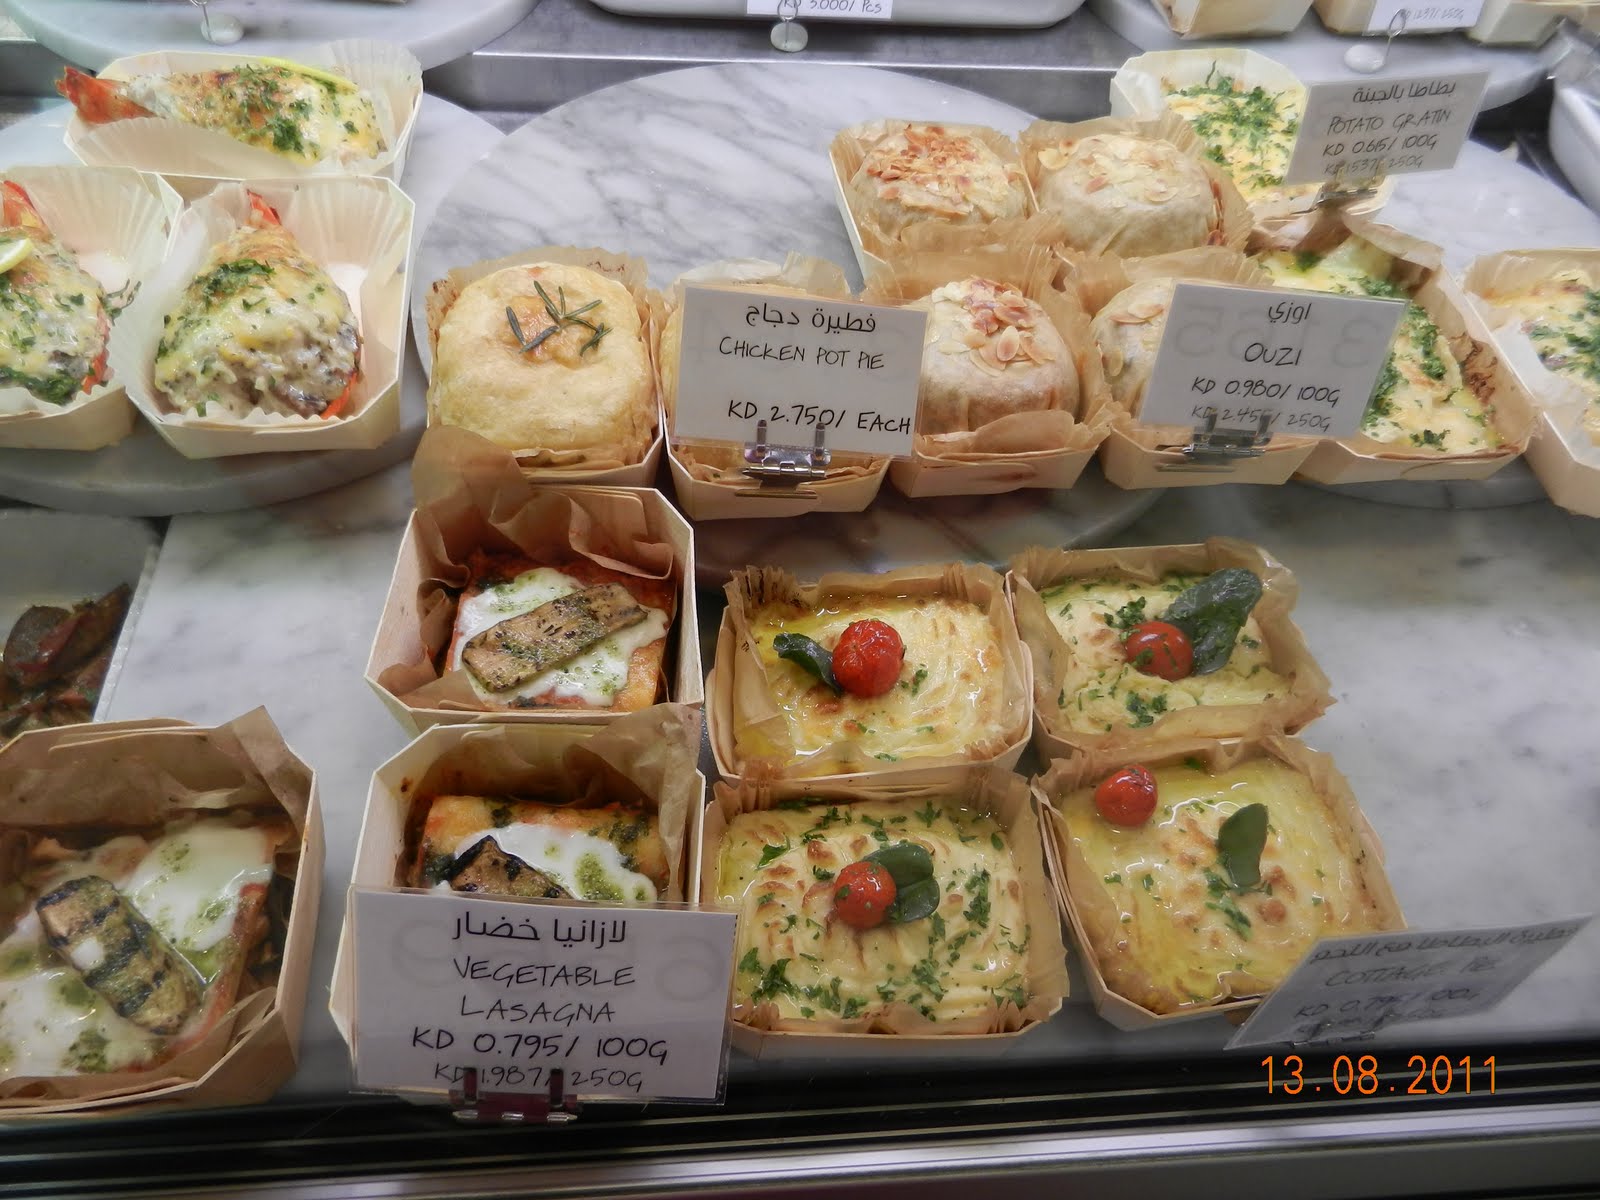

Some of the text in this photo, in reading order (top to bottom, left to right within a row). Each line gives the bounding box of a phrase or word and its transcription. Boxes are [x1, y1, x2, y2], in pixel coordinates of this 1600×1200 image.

[1327, 109, 1453, 136] POTATO GRATIN
[1322, 143, 1345, 157] KD
[1401, 133, 1440, 150] 100G
[745, 302, 877, 335] فطيرة دجاج
[1267, 301, 1313, 325] اوزي
[719, 336, 885, 370] CHICKEN POT PIE
[1243, 342, 1302, 367] OUZI
[1191, 376, 1341, 408] KD 0.980/ 100G
[727, 399, 911, 435] KD 2.750/ EACH
[1221, 406, 1281, 425] 2.45/
[1287, 413, 1330, 433] 250G
[451, 910, 627, 950] لازانيا خضار
[452, 955, 636, 989] VEGETABLE
[459, 995, 616, 1027] LASAGNA
[411, 1025, 672, 1067] KD 0.795/ 100G
[571, 1069, 643, 1094] 250G
